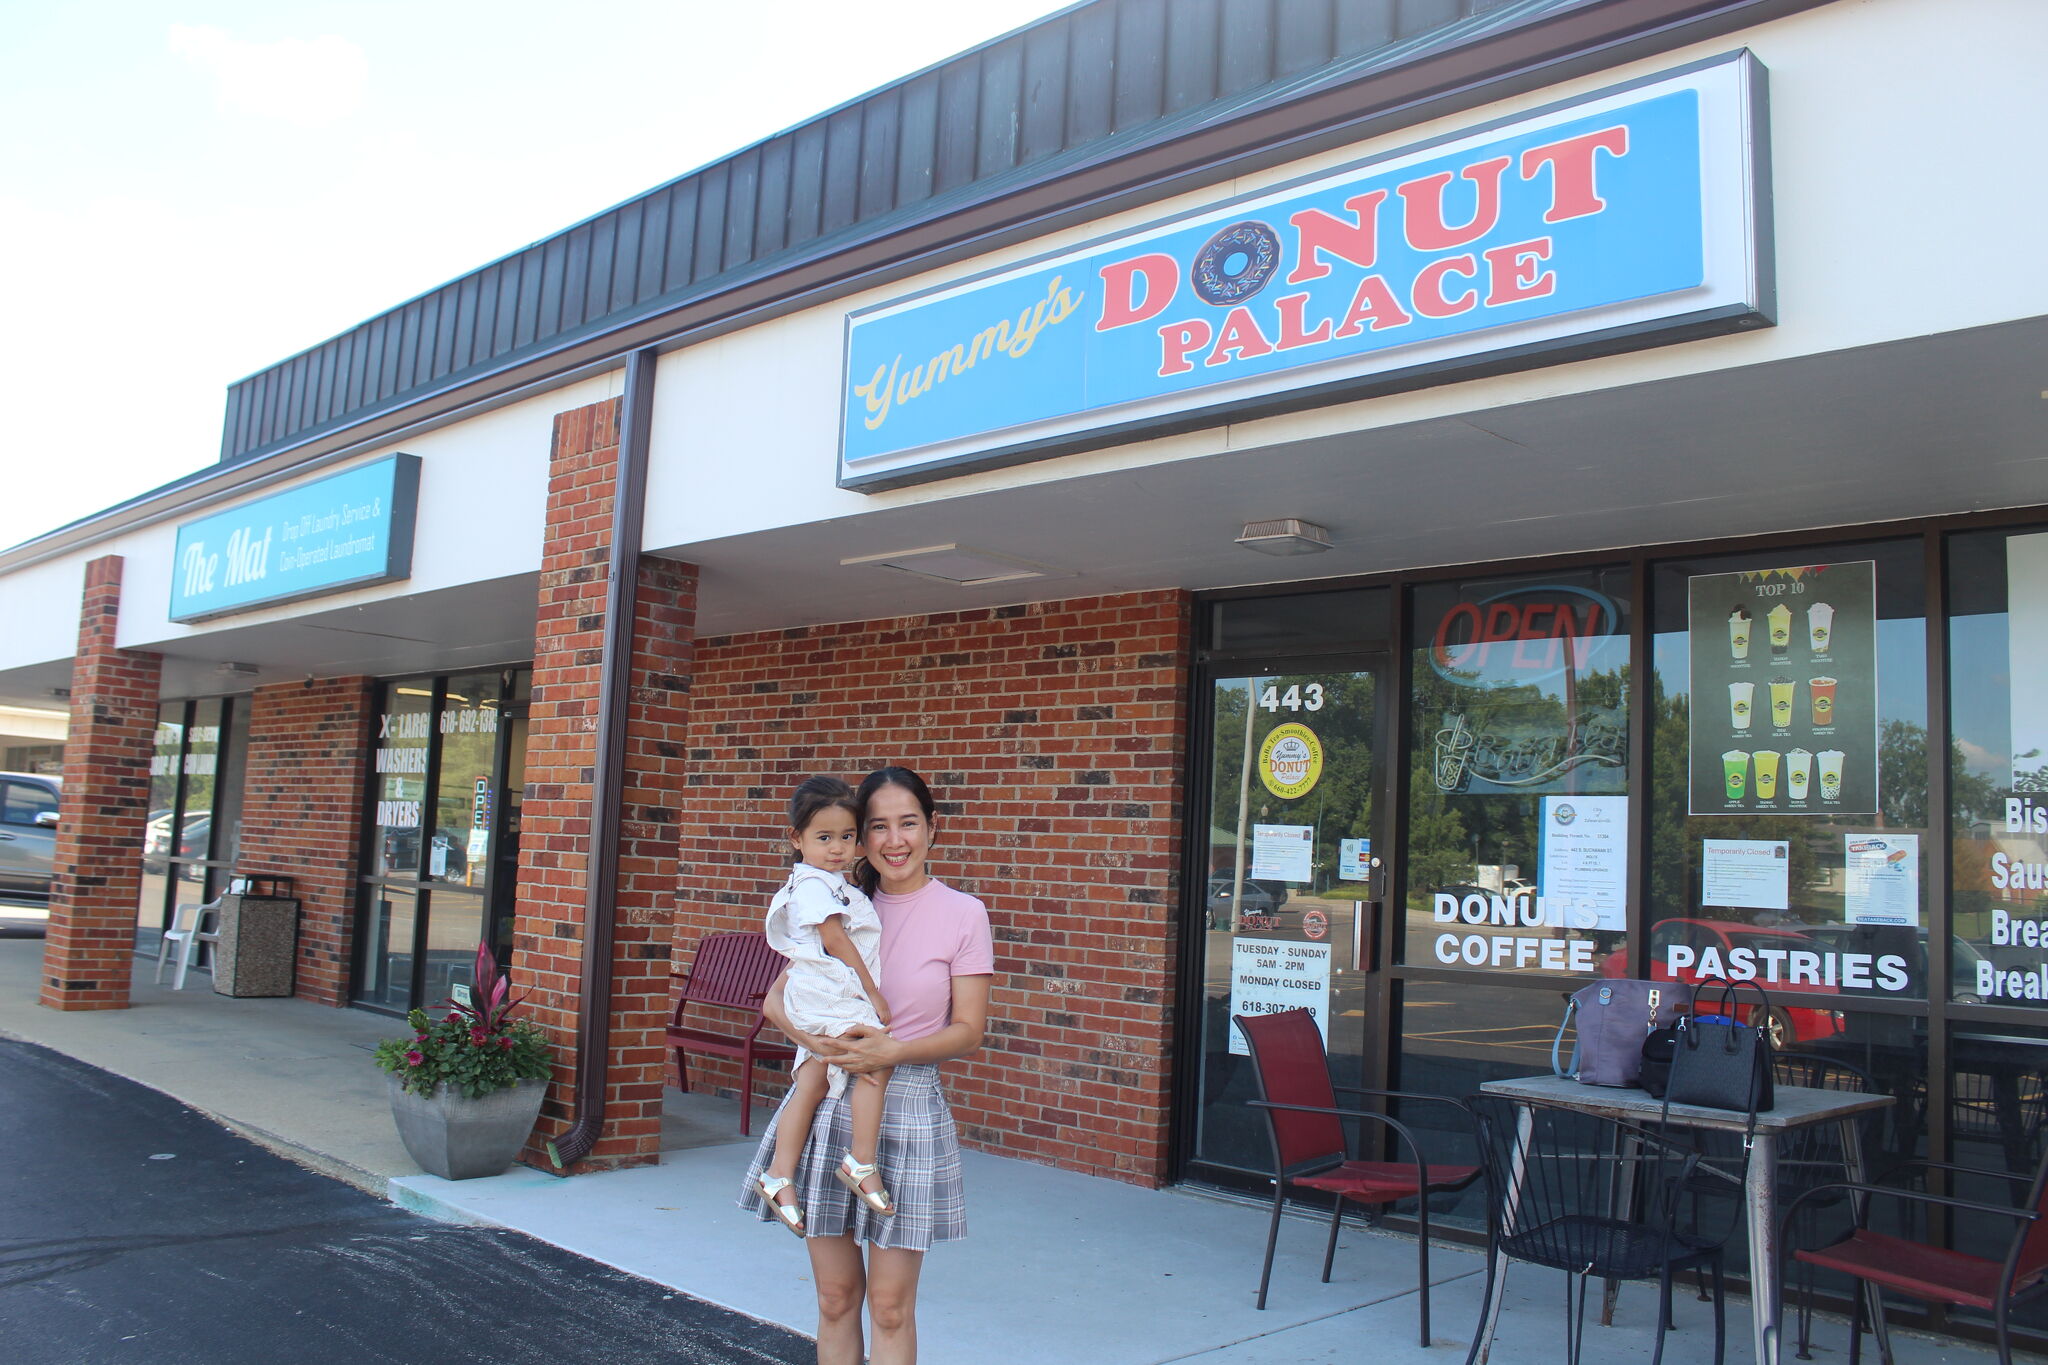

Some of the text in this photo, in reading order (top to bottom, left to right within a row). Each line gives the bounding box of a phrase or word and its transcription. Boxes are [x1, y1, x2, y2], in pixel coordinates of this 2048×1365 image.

[854, 125, 1629, 430] Yummy's DONUT
[1158, 237, 1556, 377] PALACE
[312, 507, 339, 533] Laundry
[341, 503, 371, 526] Service
[372, 497, 380, 517] &
[330, 530, 375, 560] Laundromat
[183, 526, 272, 597] The Mat
[1755, 582, 1805, 597] TOP 10
[1434, 601, 1602, 670] OPEN
[1259, 683, 1324, 713] 443
[376, 748, 428, 773] WASHERS
[1269, 759, 1312, 773] DONUT
[1275, 750, 1307, 760] Yummy's
[395, 777, 404, 798] &
[376, 801, 419, 827] DRYERS
[1707, 847, 1745, 855] Temporarily
[1434, 893, 1600, 929] DONUTS
[1236, 944, 1279, 955] TUESDAY
[1287, 947, 1327, 959] SUNDAY
[1256, 959, 1277, 969] 5AM
[1285, 961, 1305, 971] 2PM
[1434, 933, 1595, 972] COFFEE
[1667, 944, 1909, 991] PASTRIES
[1240, 975, 1321, 991] MONDAY CLOSED
